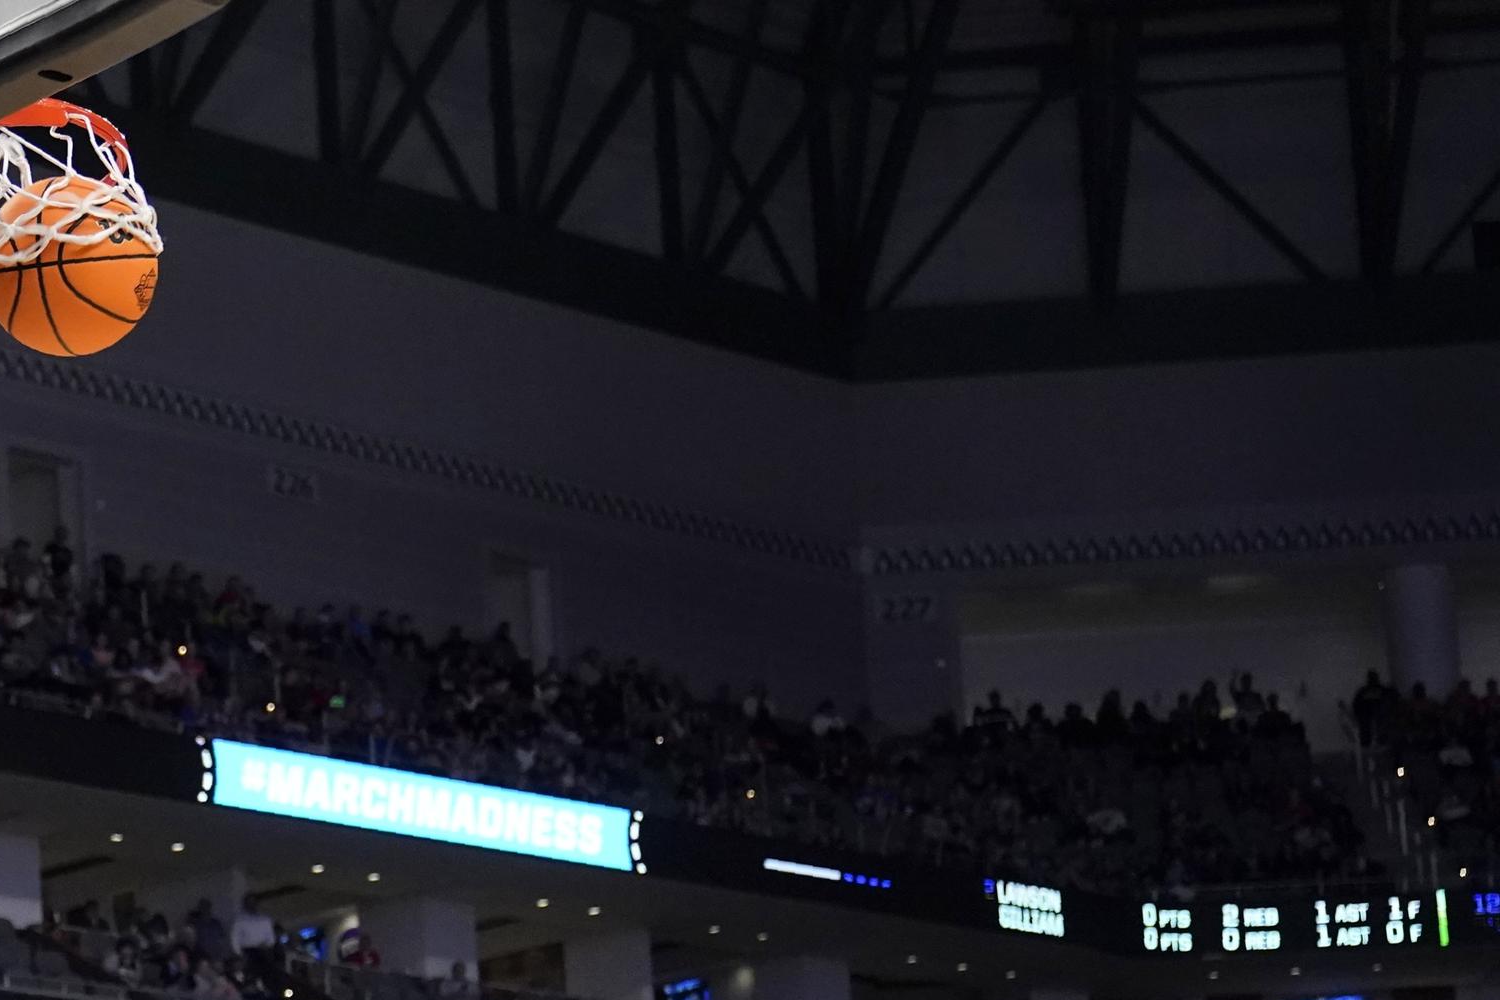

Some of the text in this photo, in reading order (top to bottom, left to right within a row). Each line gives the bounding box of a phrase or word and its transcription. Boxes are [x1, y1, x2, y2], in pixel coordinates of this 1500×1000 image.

[241, 757, 602, 855] #MARCHMADNESS
[1315, 901, 1330, 924] 1
[1335, 903, 1368, 923] AST
[1389, 897, 1403, 920] 1
[1316, 924, 1331, 947] 1
[1337, 926, 1370, 946] AST
